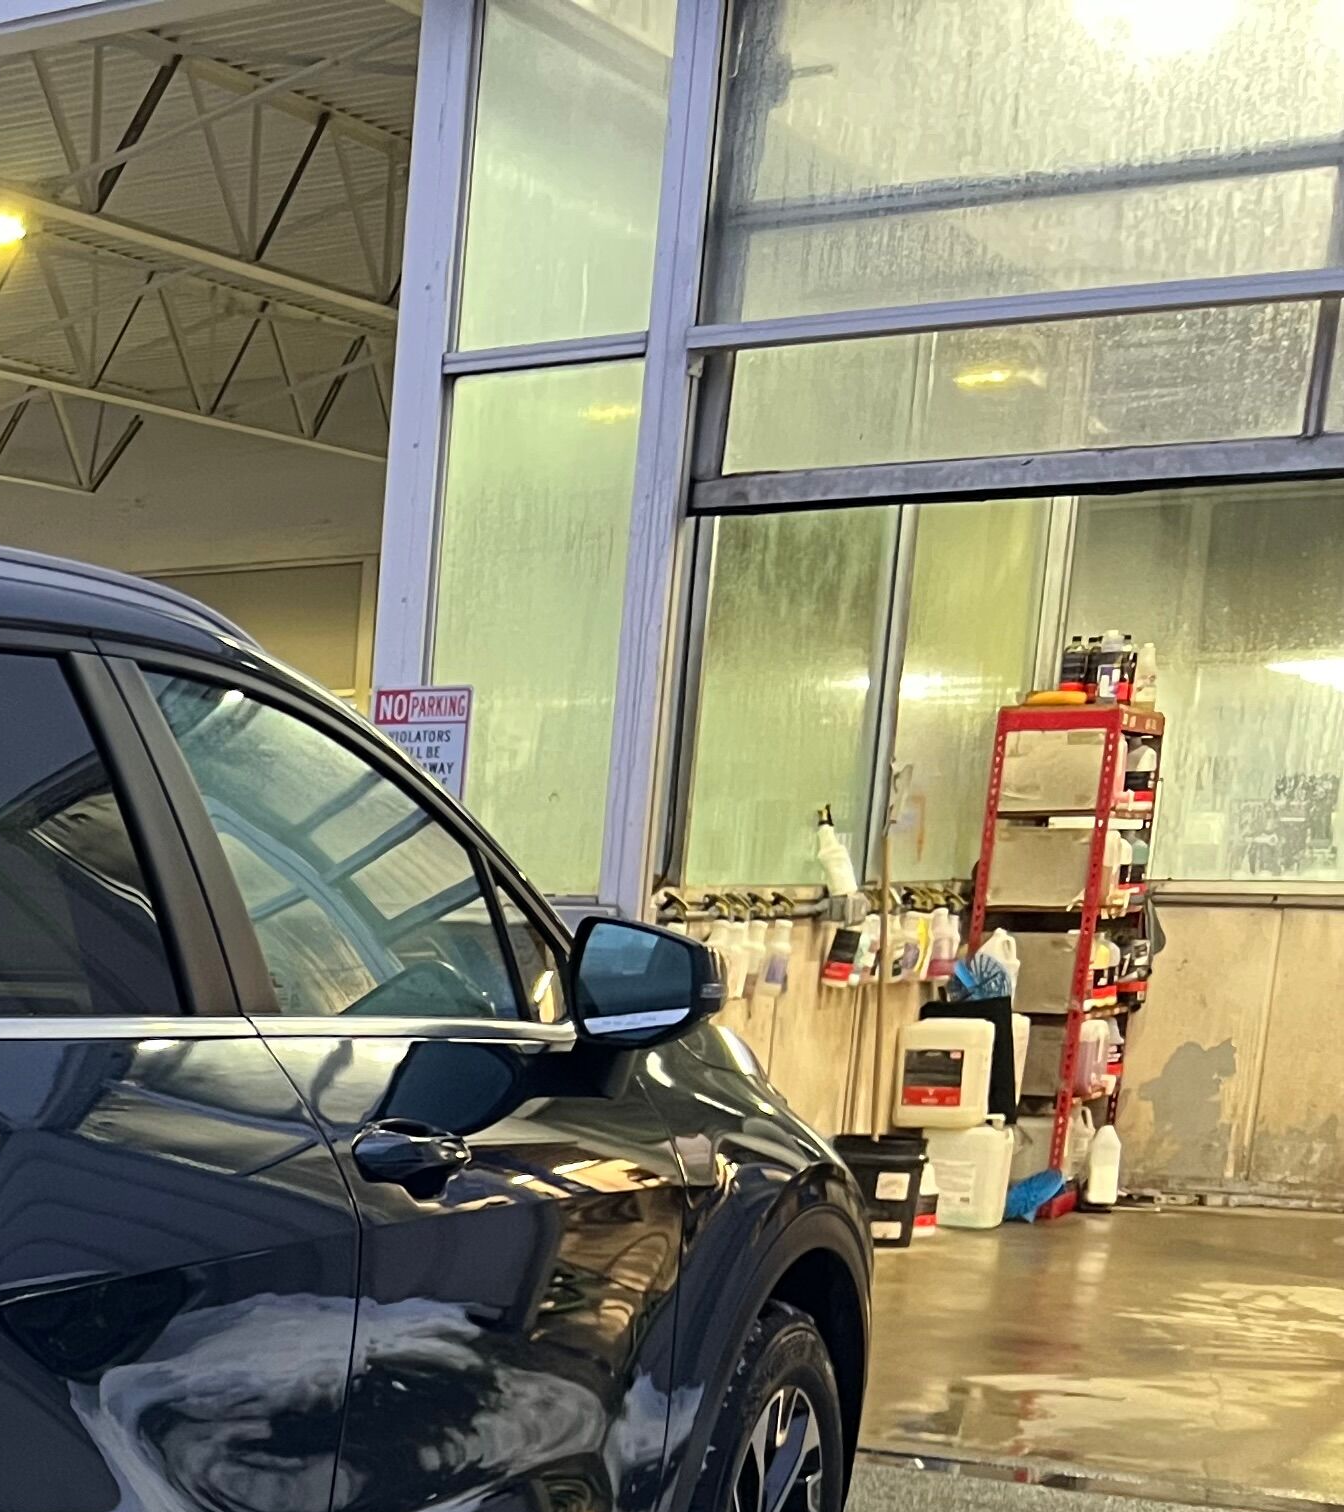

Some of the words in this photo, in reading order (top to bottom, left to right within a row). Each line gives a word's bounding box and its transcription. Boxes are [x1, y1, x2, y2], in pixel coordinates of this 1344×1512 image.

[378, 694, 408, 720] NO
[410, 695, 466, 717] PARKING
[426, 746, 440, 759] BE
